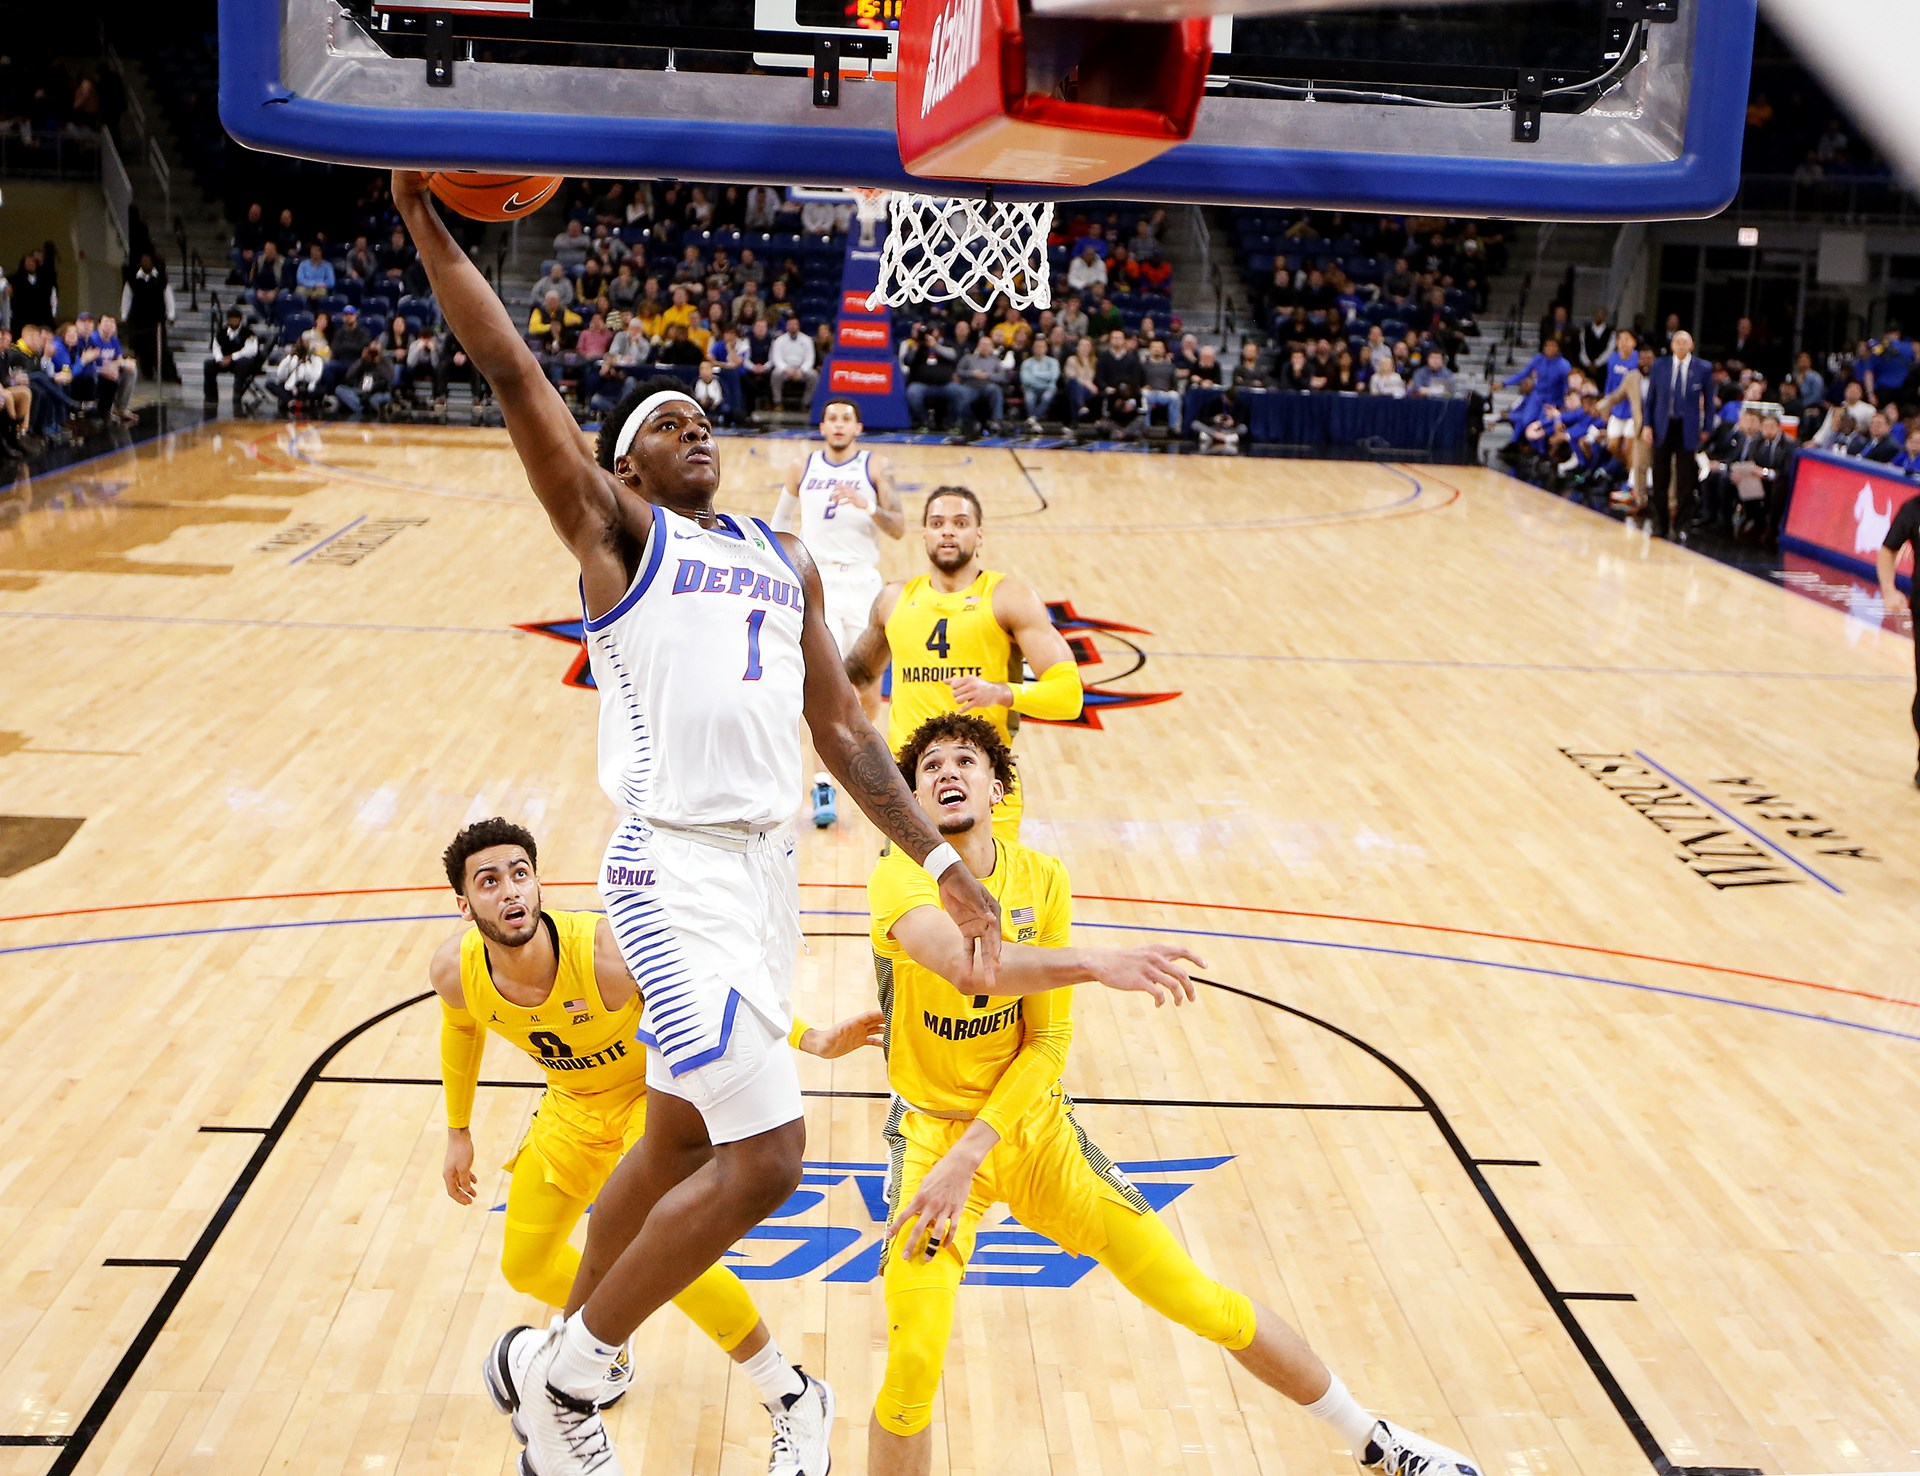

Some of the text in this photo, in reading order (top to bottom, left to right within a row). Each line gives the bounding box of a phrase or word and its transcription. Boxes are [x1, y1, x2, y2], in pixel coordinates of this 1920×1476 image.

[671, 558, 803, 614] DEPAUL
[742, 608, 767, 681] 1
[925, 618, 951, 659] 4
[606, 864, 657, 886] DEPAUL
[528, 1031, 574, 1058] 0
